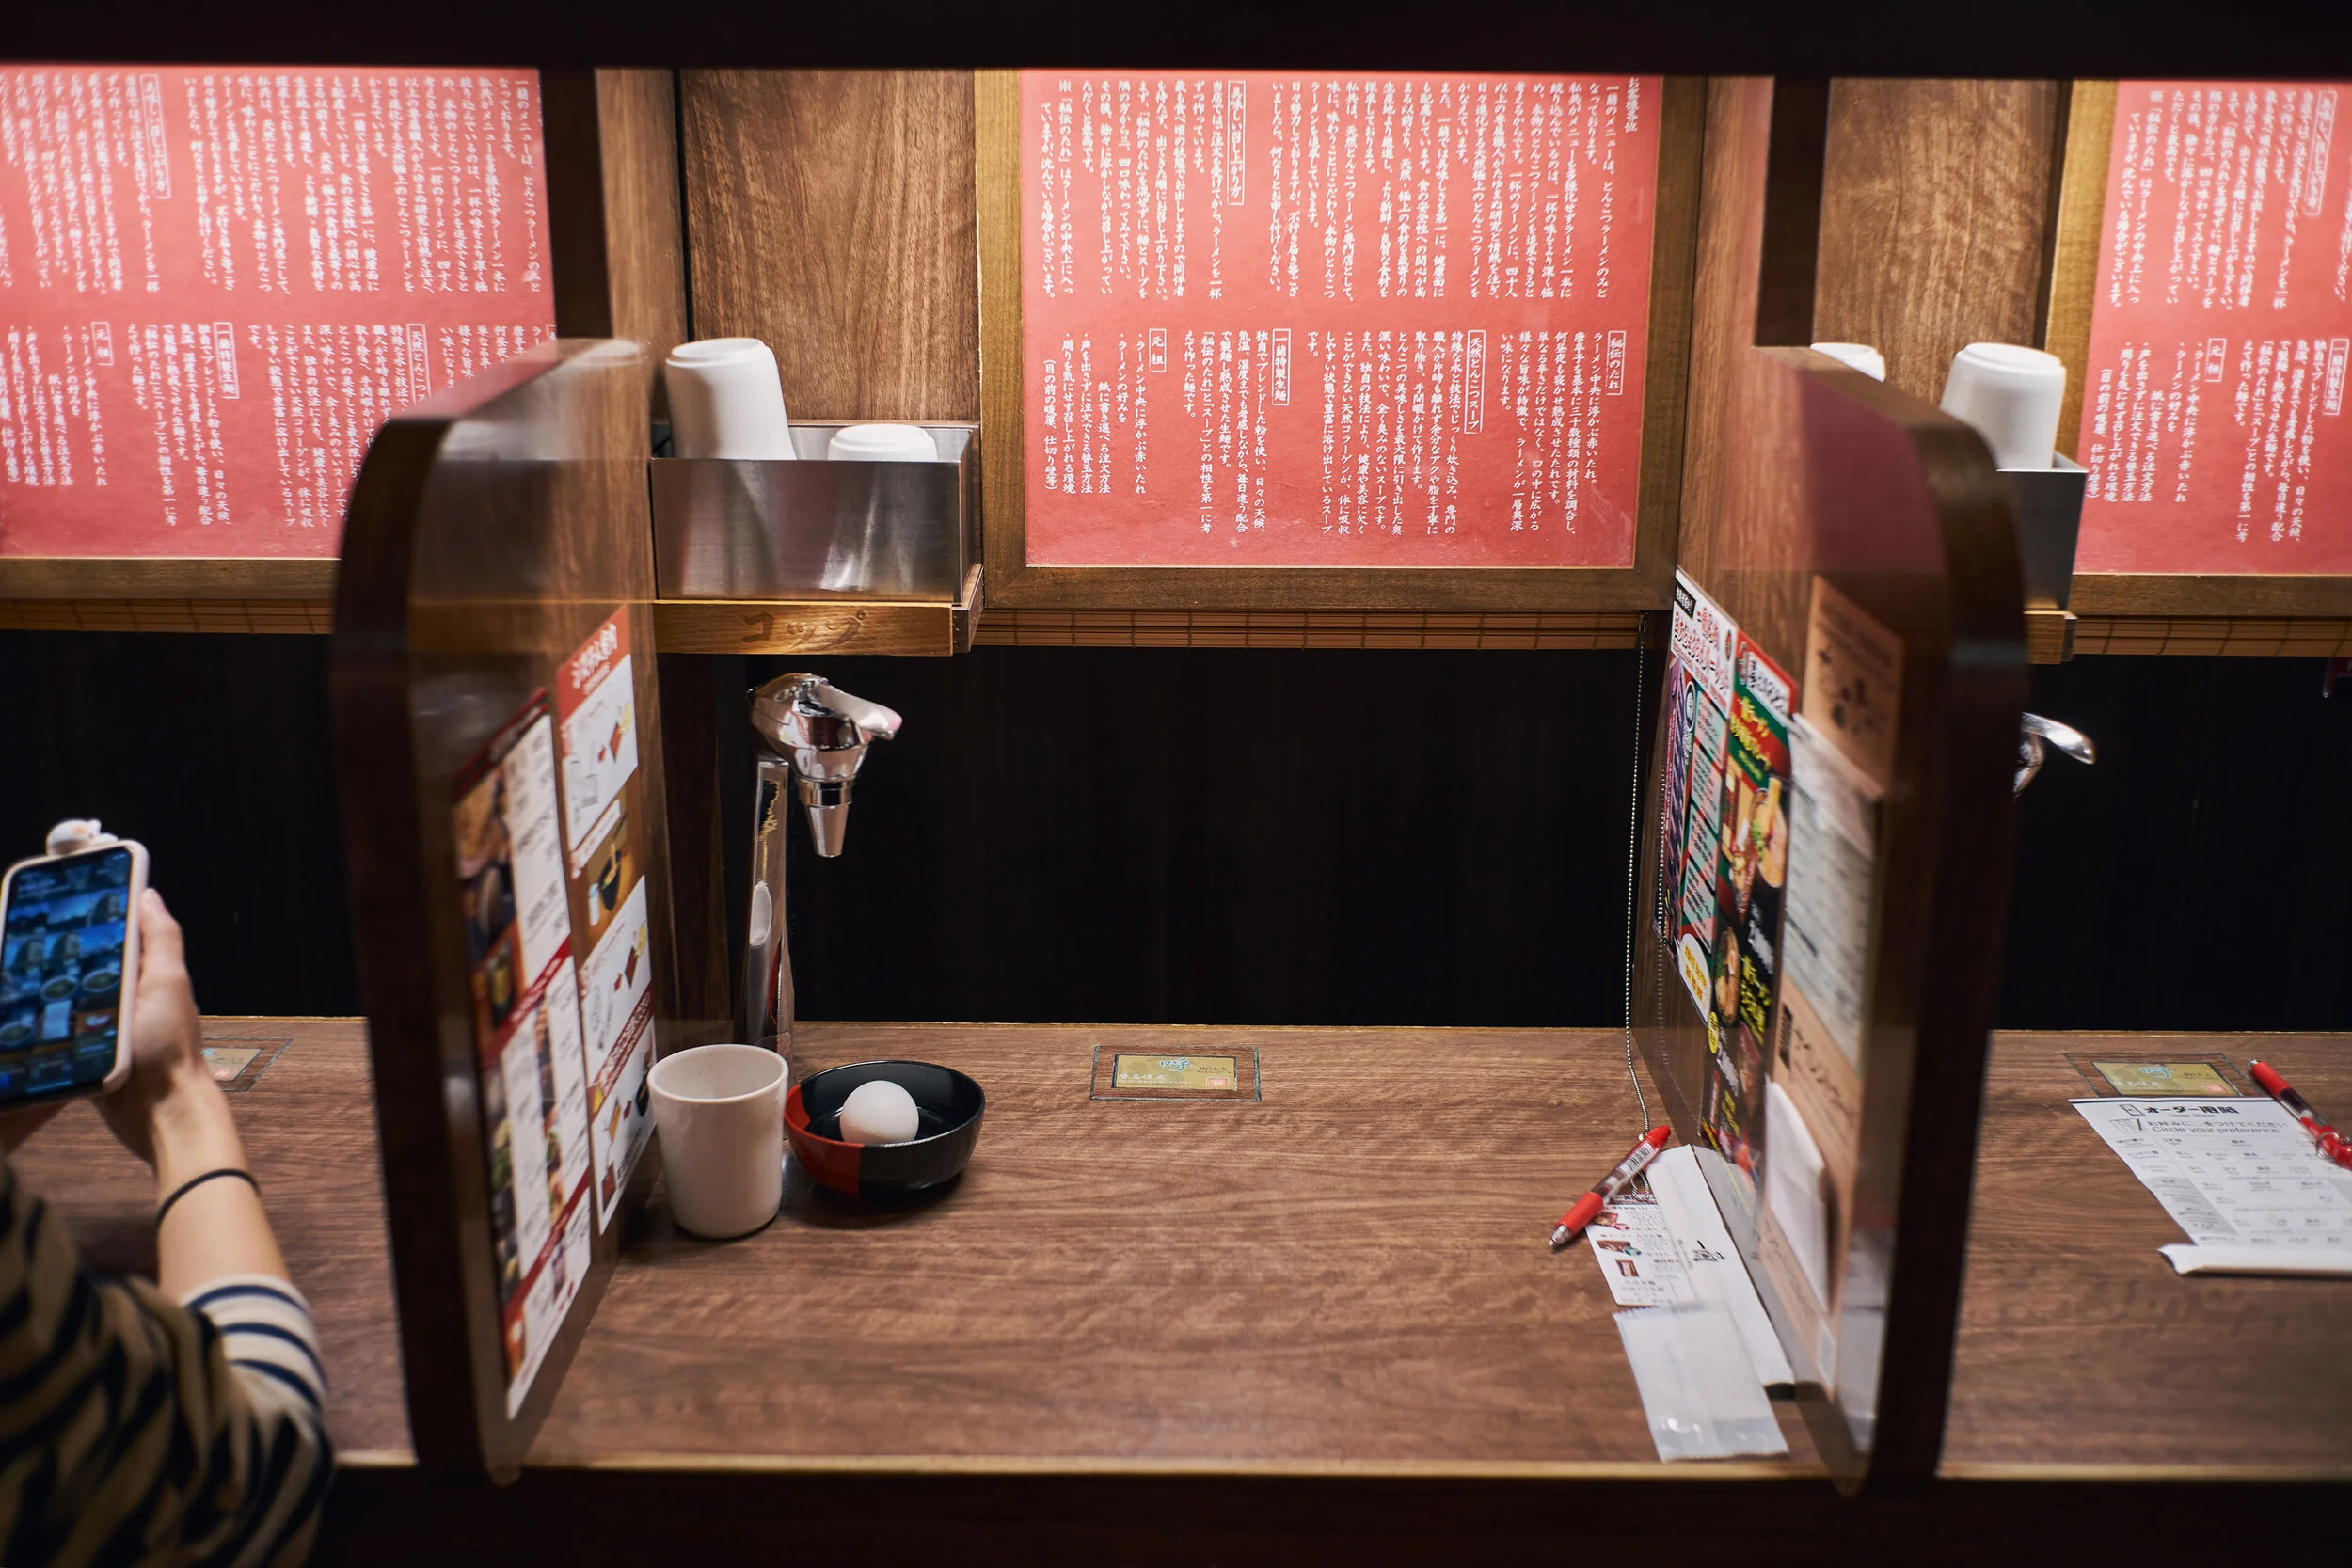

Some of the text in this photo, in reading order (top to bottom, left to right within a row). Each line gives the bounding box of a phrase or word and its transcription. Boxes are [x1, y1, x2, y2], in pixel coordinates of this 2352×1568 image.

[95, 330, 109, 358] 元祖
[248, 325, 262, 349] です。
[1152, 336, 1164, 367] 元祖
[1307, 331, 1319, 356] です。
[1116, 333, 1129, 423] ・ラーメンの好みを
[1183, 331, 1196, 418] えて作った麺です。
[1276, 337, 1288, 403] 一蘭特製生麺
[1500, 334, 1513, 410] い味になります。
[1608, 338, 1623, 390] 秘伝のたれ
[2207, 345, 2222, 374] 元祖
[1468, 337, 1482, 430] 天然とんこつスープ
[2217, 1126, 2281, 1134] preference
